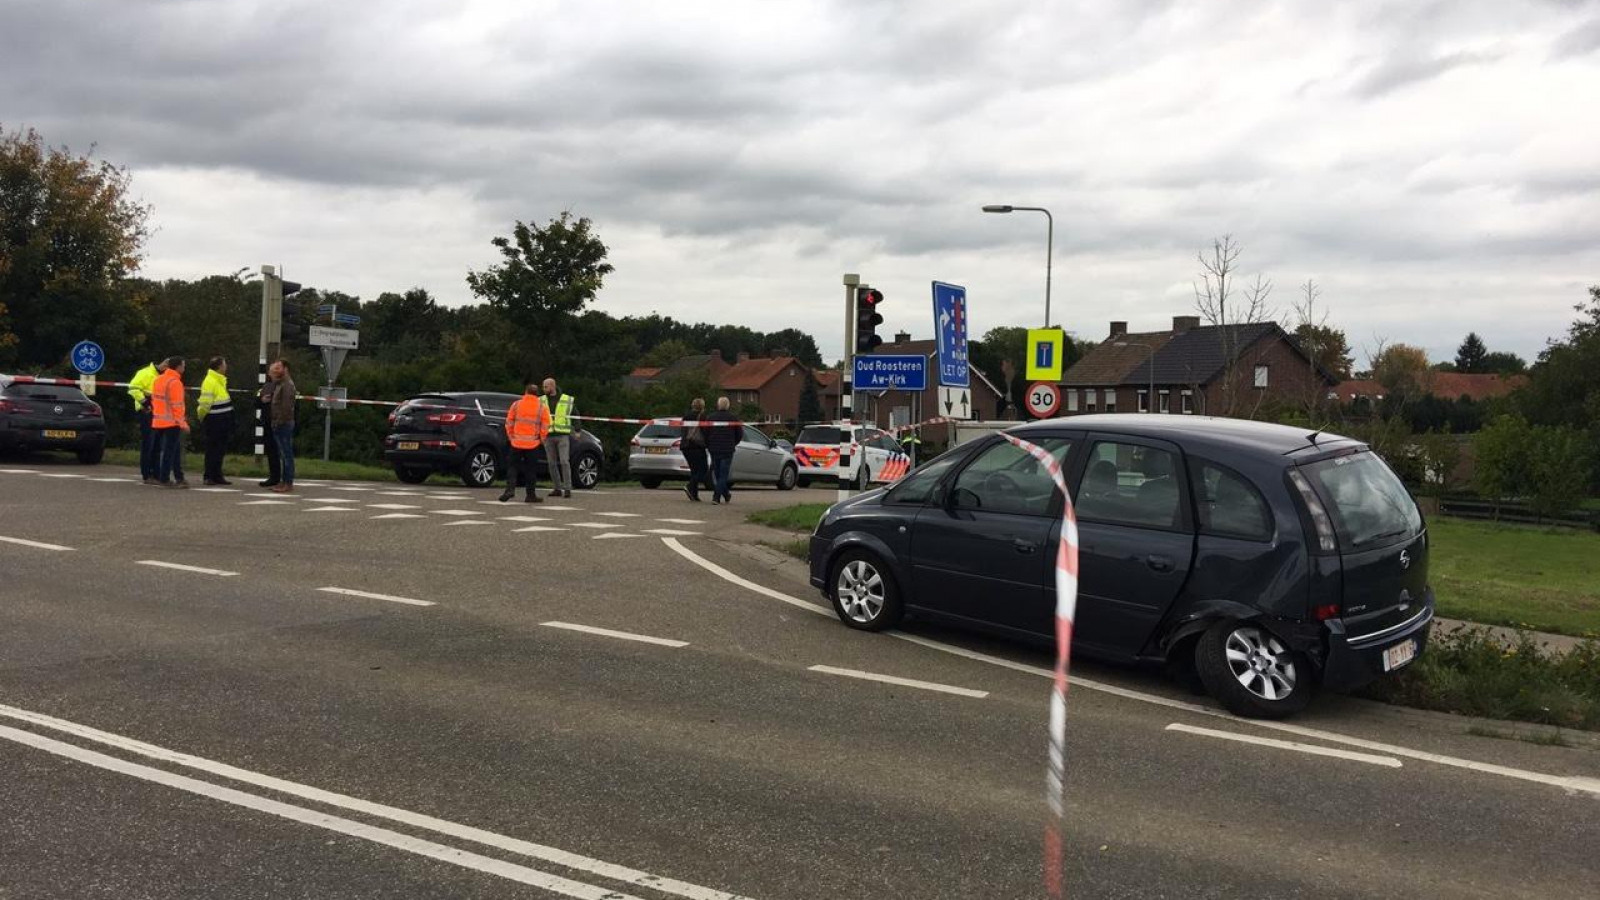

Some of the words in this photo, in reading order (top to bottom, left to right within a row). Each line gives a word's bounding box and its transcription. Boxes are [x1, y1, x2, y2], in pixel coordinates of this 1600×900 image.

[857, 360, 874, 371] Oud
[875, 361, 922, 372] Roosteren
[943, 364, 955, 376] LET
[956, 365, 967, 378] OP
[871, 373, 906, 385] Aw-Kirk
[1032, 393, 1053, 406] 30
